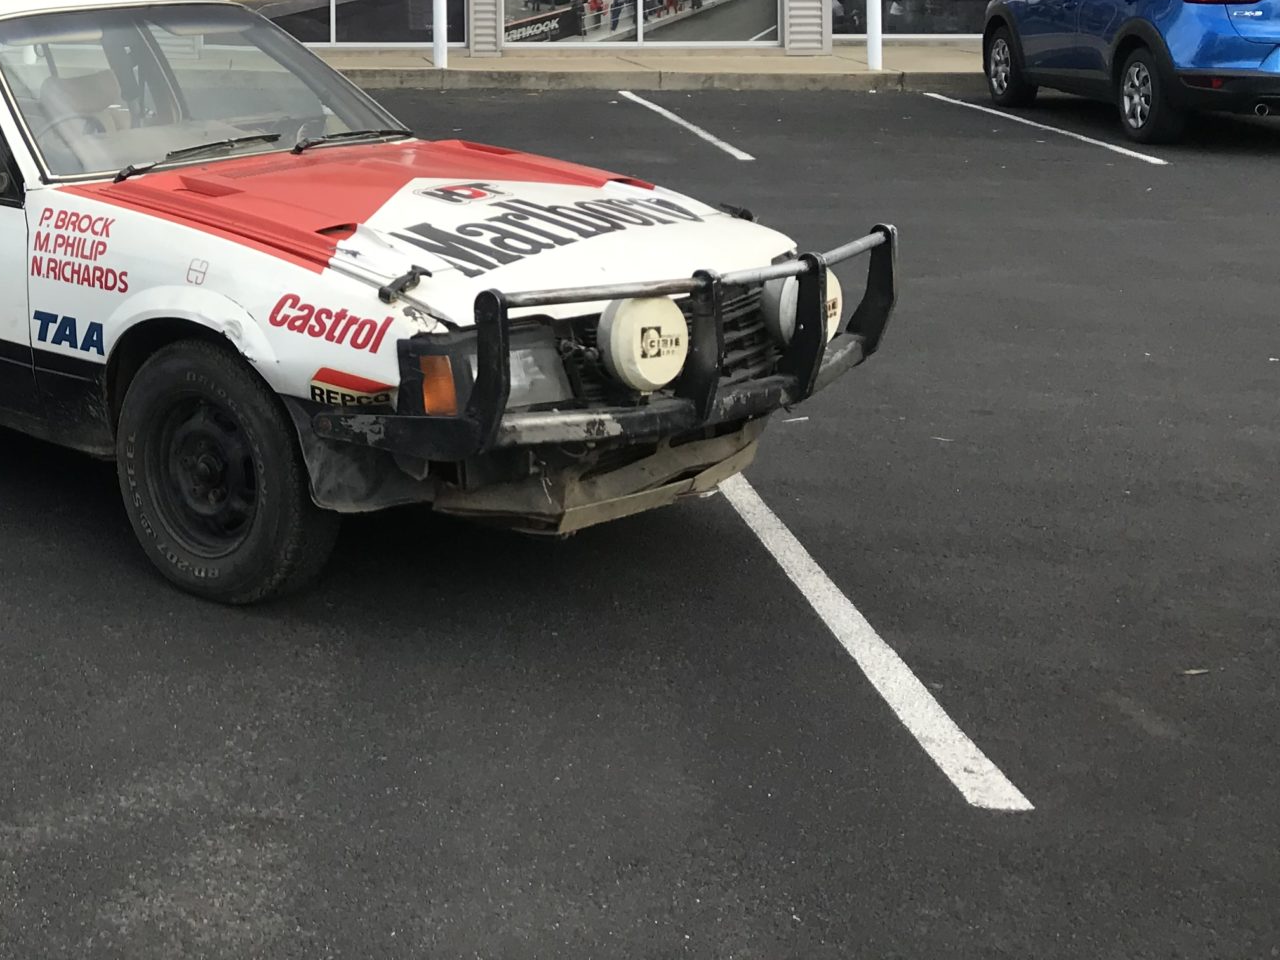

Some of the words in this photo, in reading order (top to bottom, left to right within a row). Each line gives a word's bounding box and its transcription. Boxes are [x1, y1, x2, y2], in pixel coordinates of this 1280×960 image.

[54, 210, 116, 238] BROCK
[388, 198, 705, 277] Marlboro
[33, 310, 105, 356] TAA
[269, 293, 394, 354] Castrol
[310, 385, 391, 406] REPCO
[126, 432, 143, 508] STEEL
